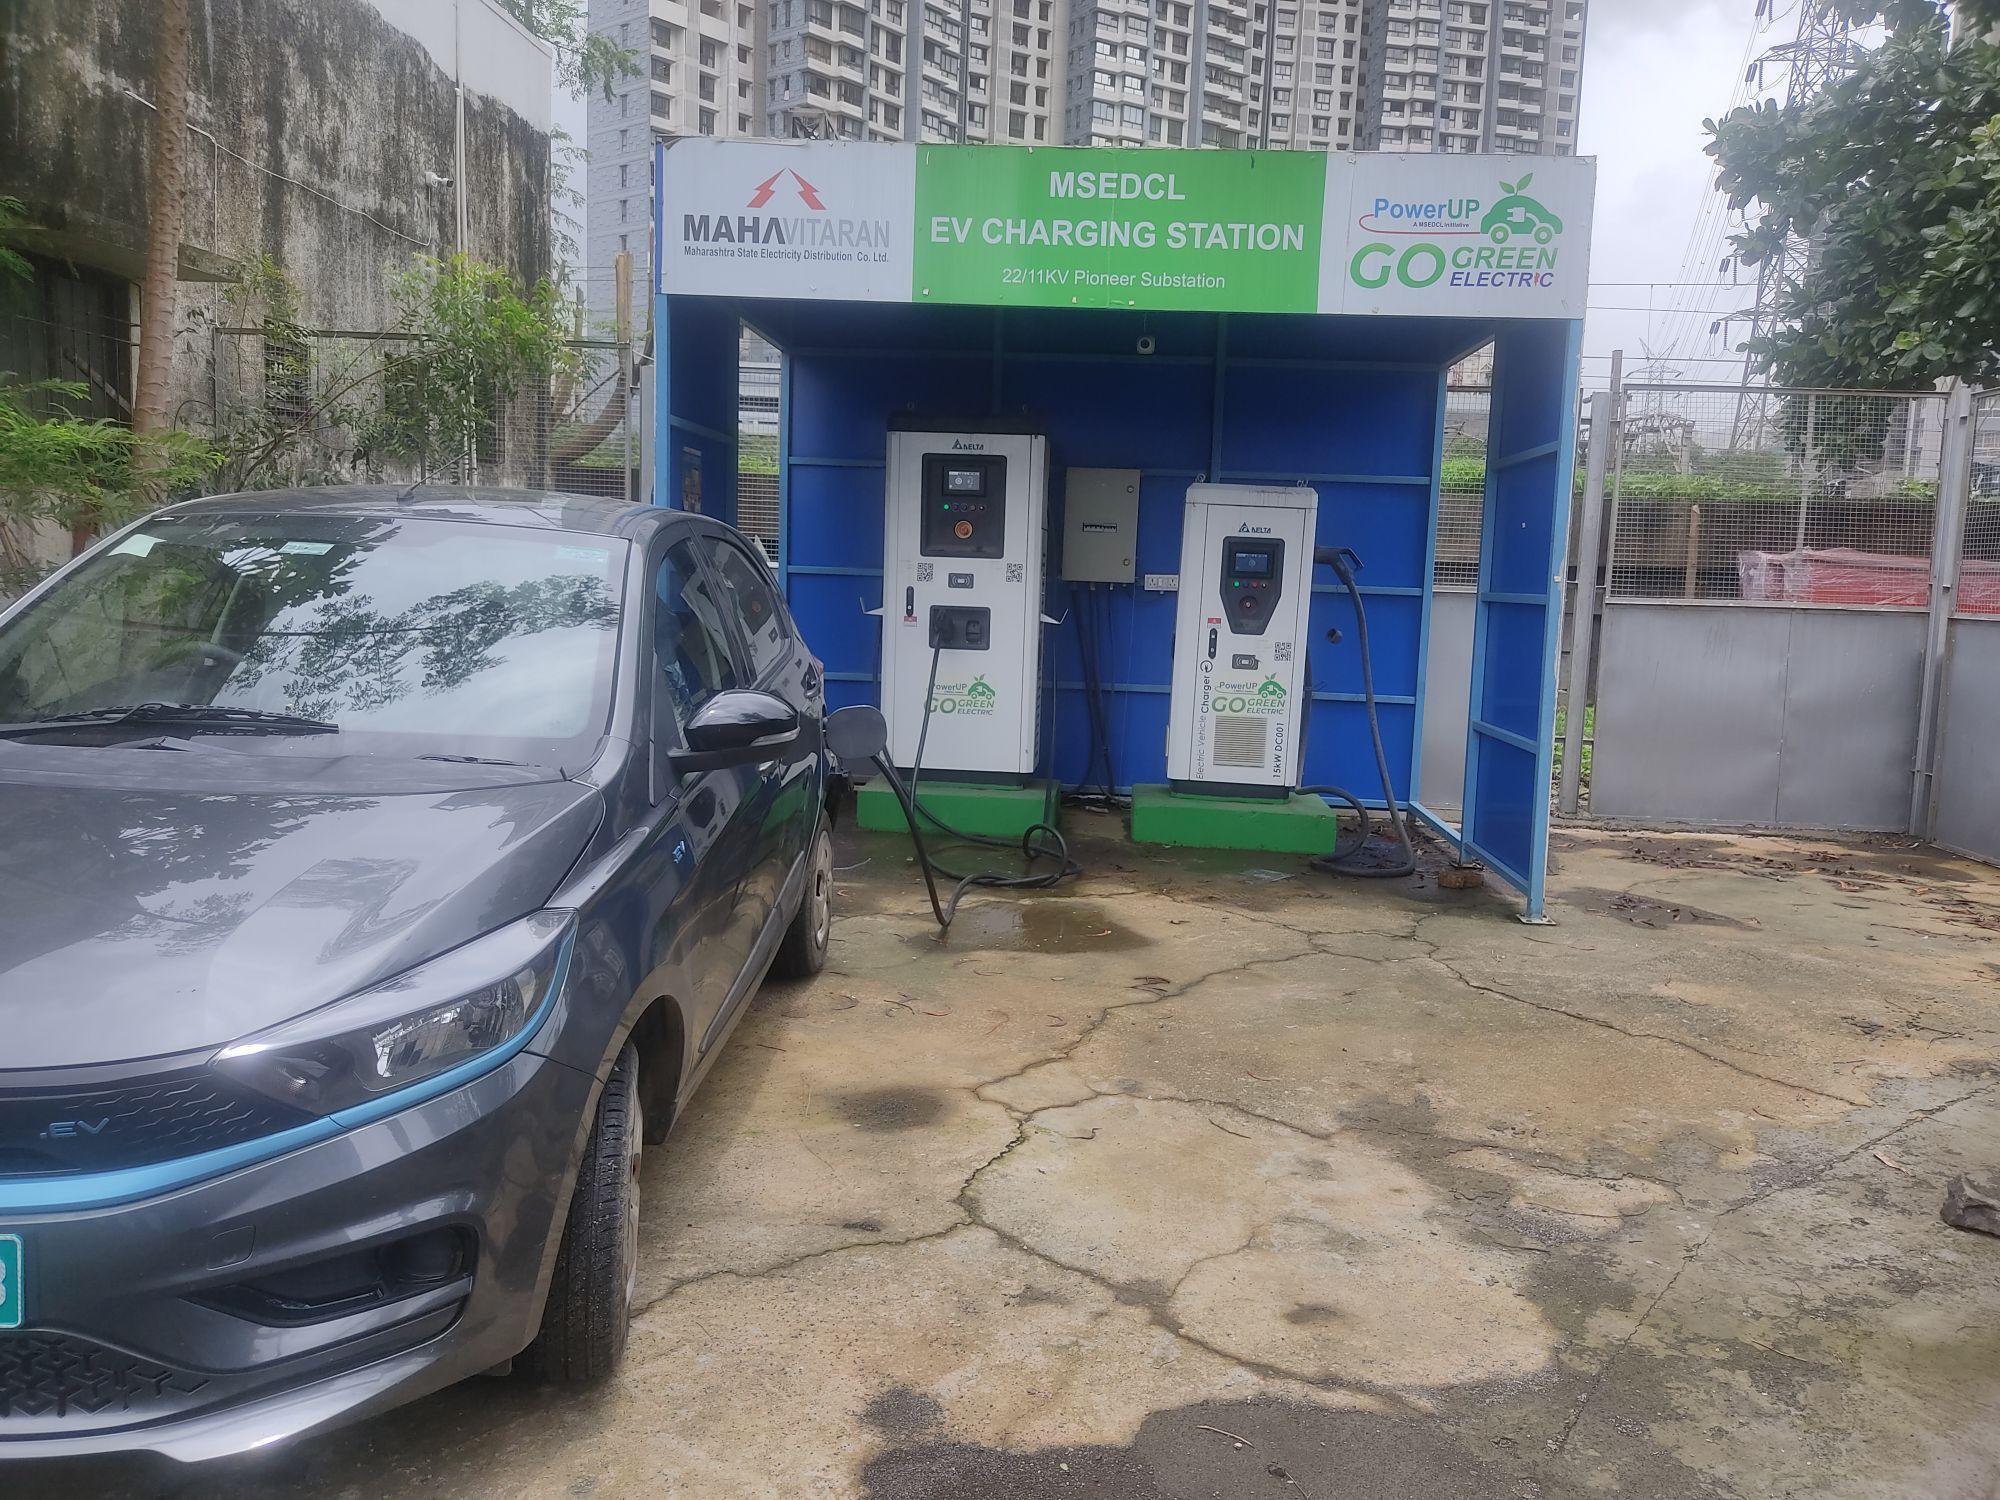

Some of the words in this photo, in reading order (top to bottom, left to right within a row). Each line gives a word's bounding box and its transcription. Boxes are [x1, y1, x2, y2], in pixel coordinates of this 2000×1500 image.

[1049, 171, 1186, 200] MSEDCL
[1374, 198, 1481, 219] PowerUP
[683, 213, 890, 249] MAHAVITARAN
[930, 216, 973, 244] EV
[981, 217, 1157, 249] CHARGING
[1166, 221, 1304, 251] STATION
[684, 245, 735, 258] Maharashtra
[737, 247, 758, 259] State
[760, 248, 801, 263] Electricity
[803, 250, 852, 262] Distribution
[856, 251, 871, 263] Co.
[873, 252, 889, 263] Ltd.
[1451, 246, 1559, 270] GREEN
[1350, 242, 1446, 289] GO
[1002, 268, 1070, 285] 22/11KV
[1074, 269, 1136, 287] Pioneer
[1141, 271, 1226, 289] Substation
[1450, 271, 1554, 288] ELECTRIC
[932, 682, 968, 691] owerUP
[1201, 675, 1211, 714] Charger
[1219, 681, 1258, 690] PowerUP
[957, 708, 994, 716] ELECTRIC
[958, 699, 995, 708] GREEN
[1211, 696, 1246, 713] GO
[1246, 707, 1285, 715] ELECTRIC
[1247, 698, 1286, 708] GREEN
[1274, 722, 1284, 752] DC001
[1273, 755, 1281, 778] 15kW
